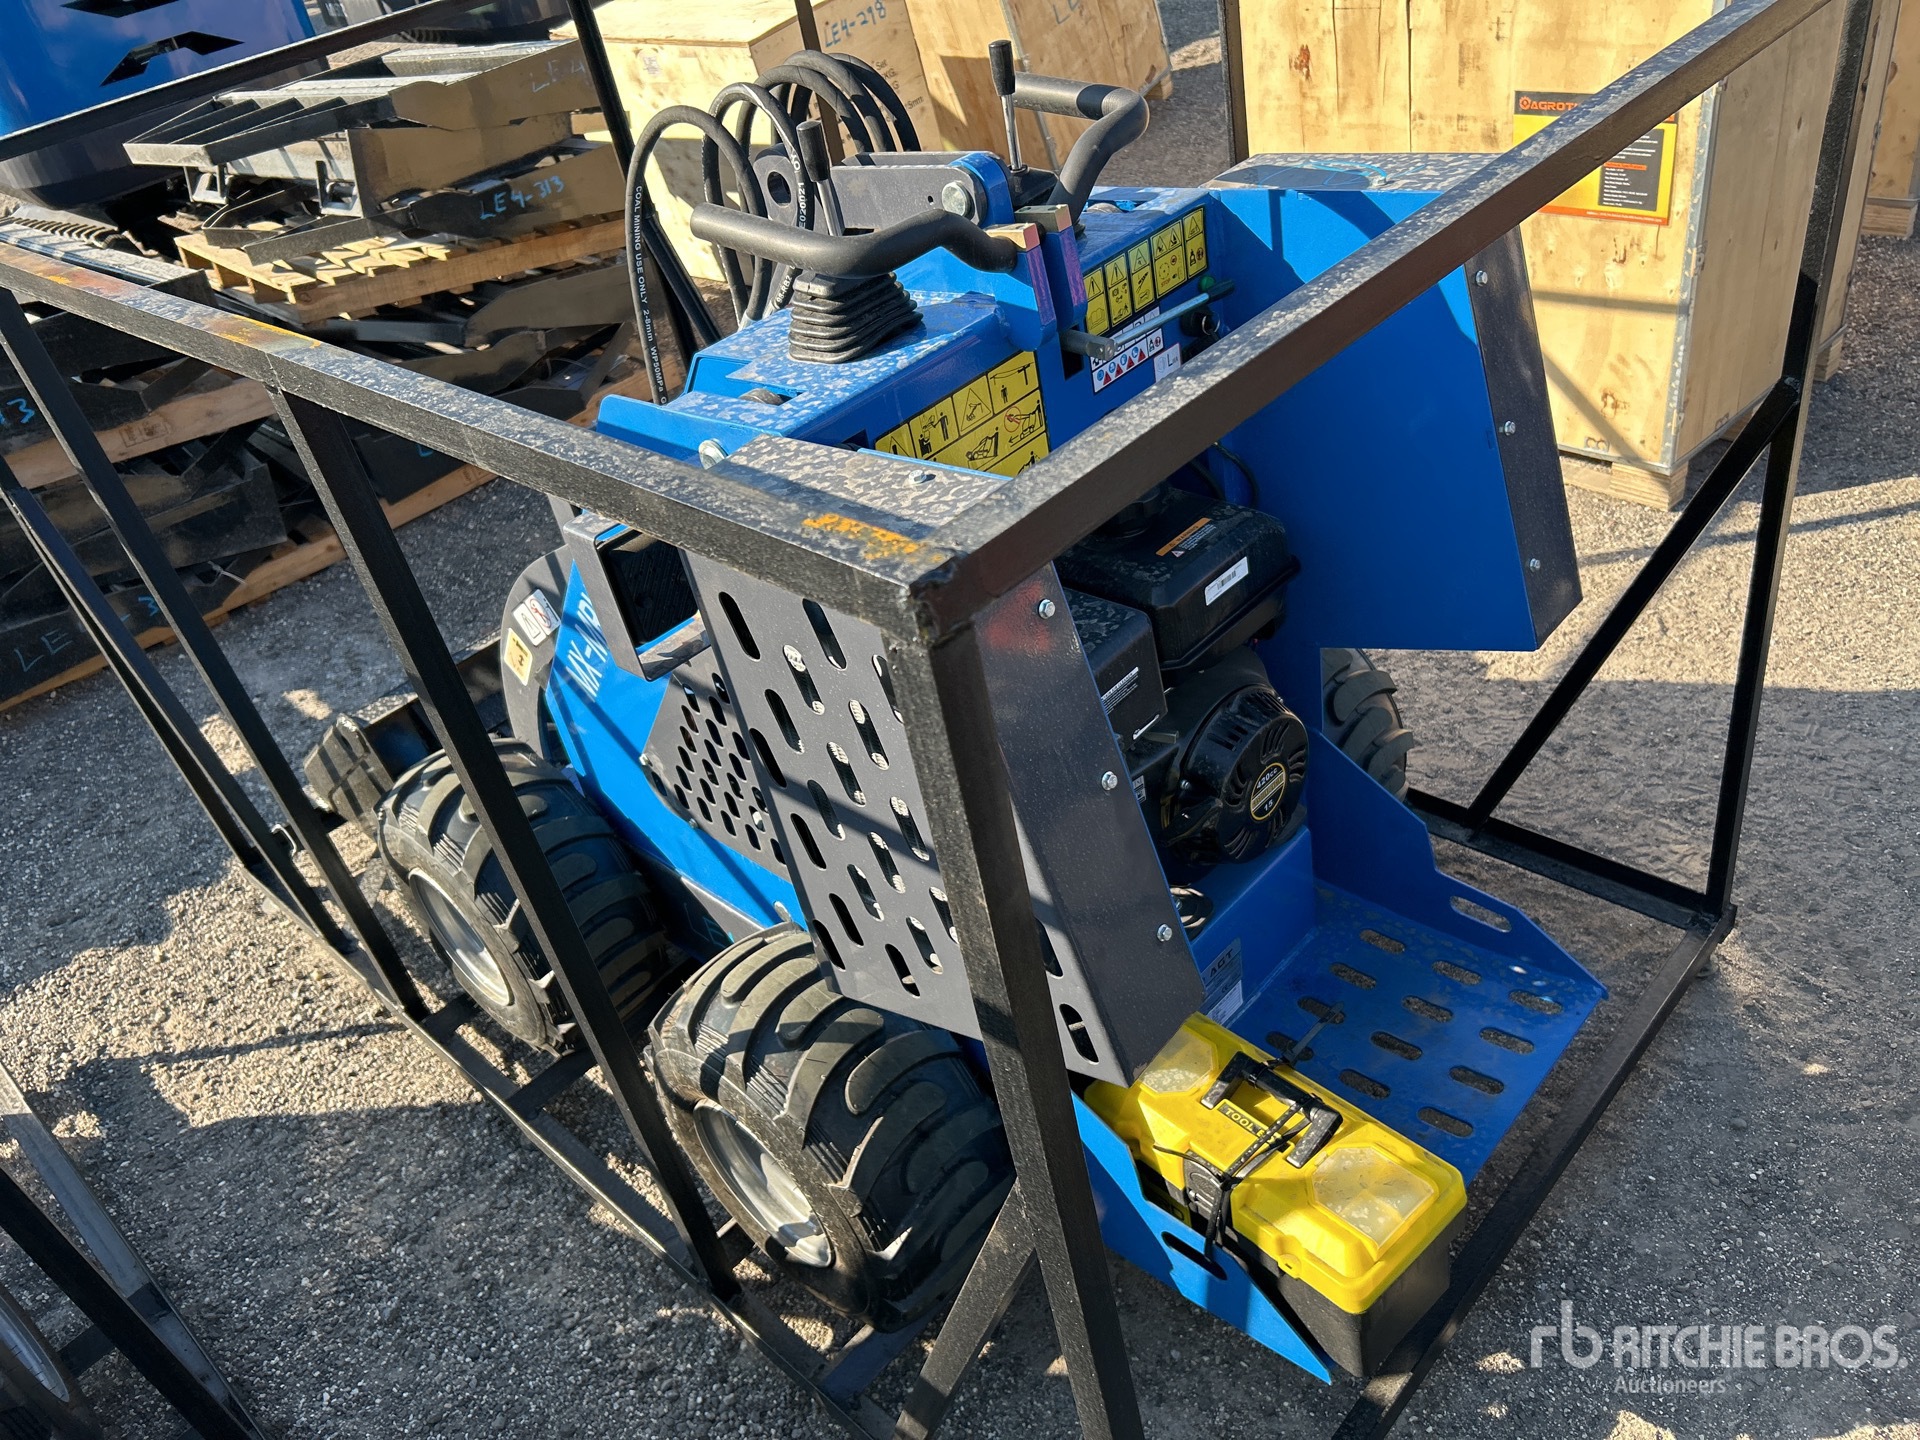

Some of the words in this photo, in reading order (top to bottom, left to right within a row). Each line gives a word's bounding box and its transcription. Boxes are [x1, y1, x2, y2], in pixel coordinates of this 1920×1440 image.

[823, 0, 887, 48] LE4-298
[1530, 101, 1578, 111] AGROT
[634, 185, 643, 213] COAL
[633, 214, 642, 251] MINING
[635, 252, 644, 274] USE
[638, 276, 648, 304] ONLY
[1225, 1107, 1254, 1132] TOOL
